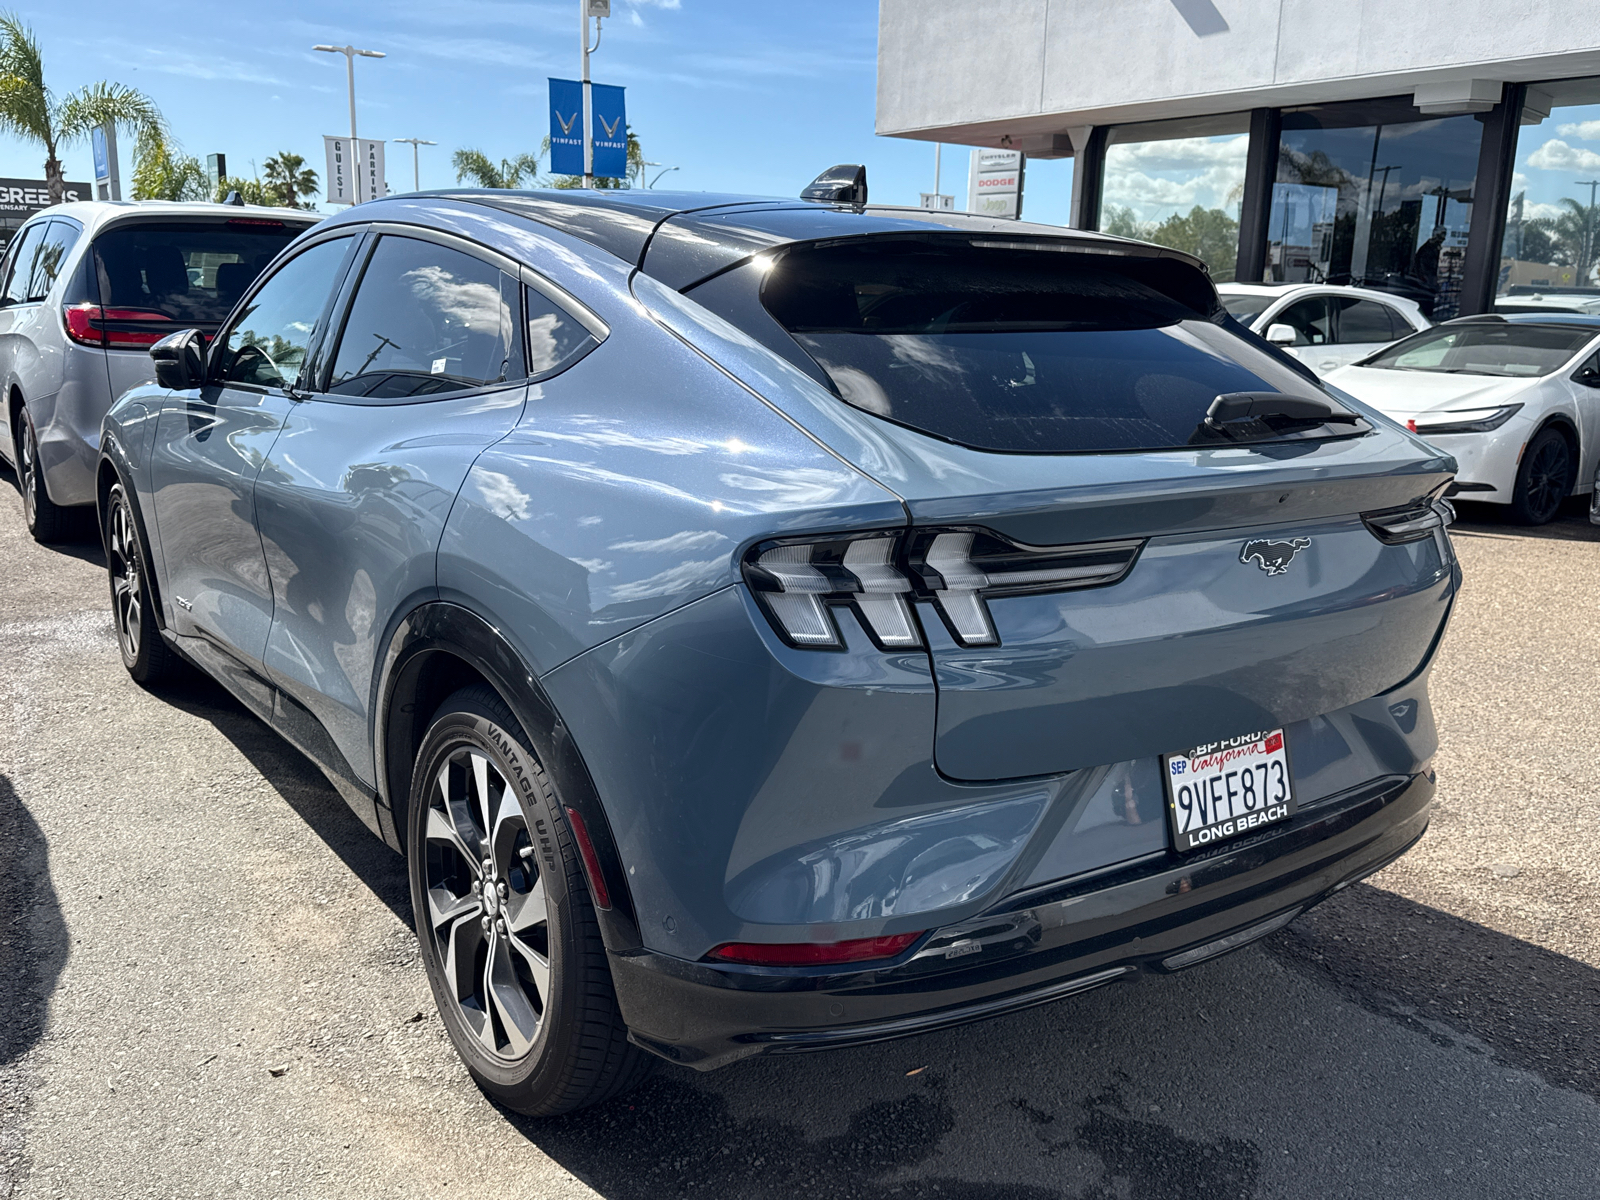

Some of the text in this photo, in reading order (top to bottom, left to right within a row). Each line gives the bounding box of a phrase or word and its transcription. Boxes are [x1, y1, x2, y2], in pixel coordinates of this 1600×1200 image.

[552, 137, 582, 146] VINFAST
[595, 141, 625, 149] VINFAST
[335, 141, 343, 198] GUEST
[978, 177, 1015, 187] DODGE
[0, 186, 79, 204] GREES
[983, 198, 1007, 212] Jeep
[1191, 743, 1266, 773] California
[1171, 760, 1186, 775] SEP
[487, 723, 556, 872] VANTAGE UHP
[1178, 760, 1286, 832] 9VFF873
[1188, 821, 1234, 846] LONG
[1237, 804, 1287, 831] BEACH
